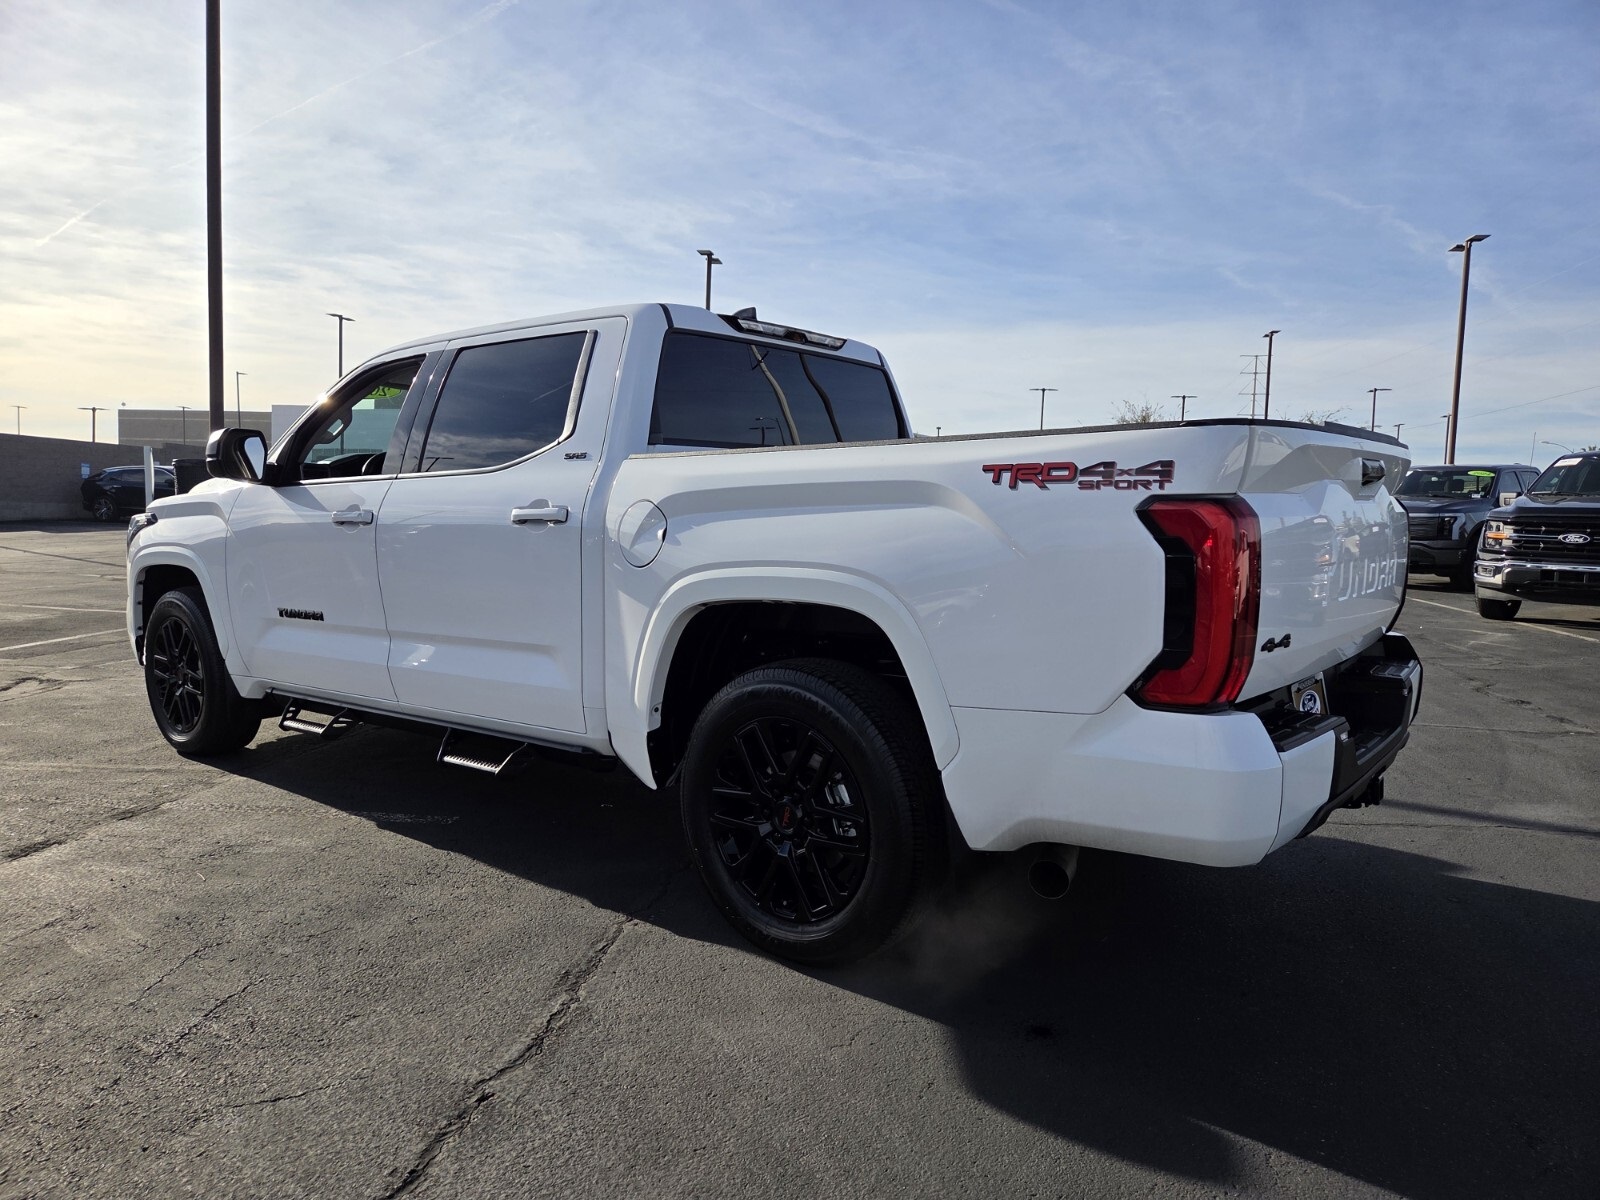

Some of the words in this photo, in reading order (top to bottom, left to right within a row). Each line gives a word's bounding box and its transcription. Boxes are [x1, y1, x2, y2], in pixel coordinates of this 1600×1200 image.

[982, 462, 1079, 490] TRD
[1077, 479, 1173, 490] SPORT
[277, 607, 325, 621] TUNDRA
